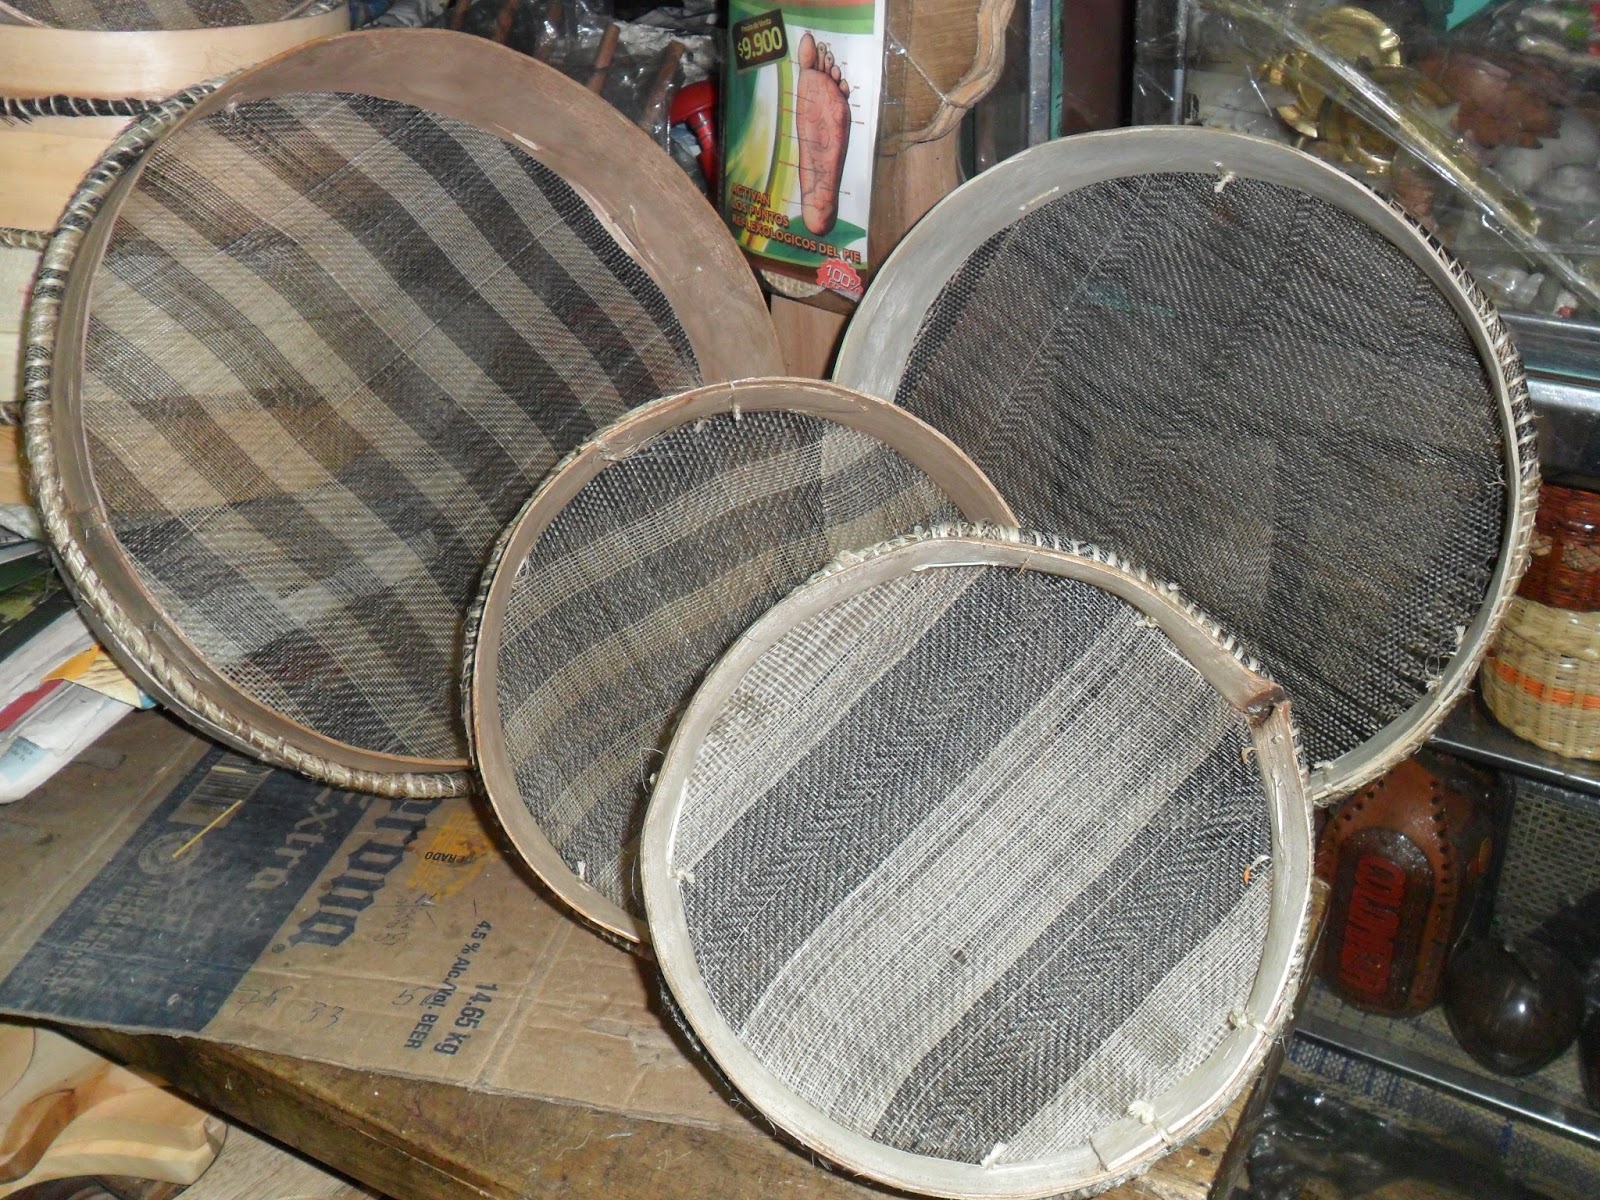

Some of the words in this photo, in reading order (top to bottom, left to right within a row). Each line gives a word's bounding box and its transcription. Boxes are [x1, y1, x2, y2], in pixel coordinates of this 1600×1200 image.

[737, 26, 783, 60] $9.900
[731, 182, 771, 207] ACTIVAN
[732, 200, 747, 213] LOS
[749, 204, 789, 227] PUNTOS
[732, 215, 817, 252] REFLEXOLOGICOS
[818, 242, 840, 258] DEL
[842, 249, 861, 263] PIE
[471, 920, 493, 940] 4.5
[454, 983, 498, 1029] 14.65
[403, 1013, 440, 1049] BEER
[433, 1031, 472, 1056] kg
